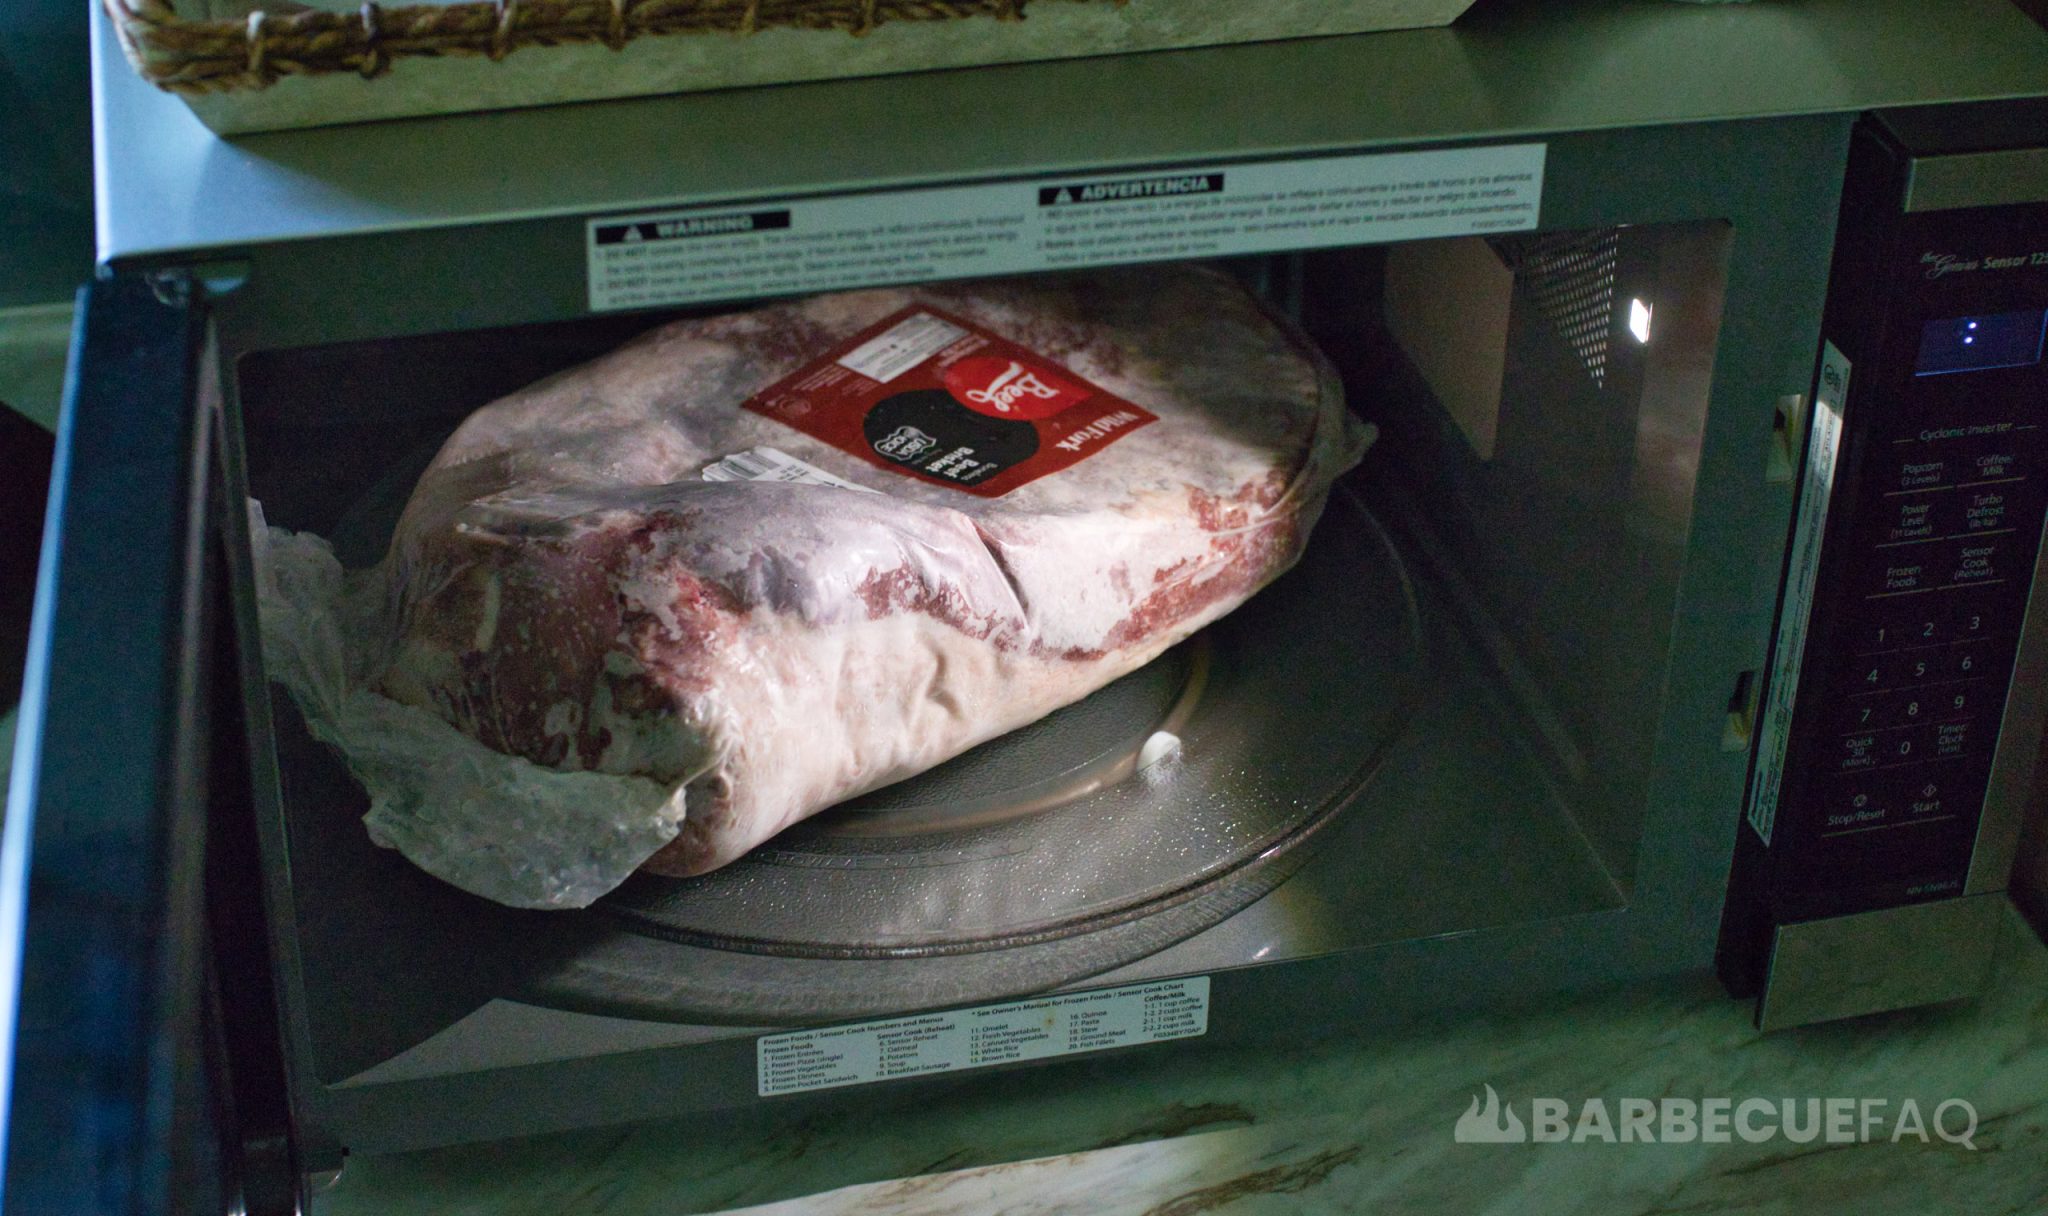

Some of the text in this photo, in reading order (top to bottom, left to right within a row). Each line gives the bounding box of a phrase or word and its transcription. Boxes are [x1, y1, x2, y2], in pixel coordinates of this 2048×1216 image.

[1082, 177, 1209, 200] ADVERTENCIA
[657, 216, 753, 236] WARNING
[1984, 256, 2027, 269] Sensor
[966, 361, 1060, 412] Beef
[1055, 410, 1139, 451] Wild Fork
[1920, 422, 2013, 441] Cyclonic Inverter
[925, 447, 974, 472] Brisket
[943, 459, 980, 478] Beef
[1903, 462, 1943, 474] Popcorn
[1982, 465, 2004, 476] Milk
[1973, 494, 2003, 506] Turbo
[1901, 505, 1930, 514] Power
[1967, 507, 2004, 518] Defrost
[1902, 514, 1925, 526] Level
[1960, 546, 1994, 558] Sensor
[1963, 557, 1988, 569] Cook
[1887, 566, 1921, 576] Frozen
[1886, 576, 1917, 588] Foods
[1923, 622, 1934, 636] 2
[1969, 616, 1980, 630] 3
[1879, 628, 1885, 642] 1
[1961, 656, 1971, 670] 6
[1915, 662, 1926, 677] 5
[1867, 669, 1878, 683] 4
[1953, 695, 1964, 709] 9
[1908, 702, 1919, 715] 8
[1862, 708, 1871, 722] 7
[1846, 736, 1874, 748] Quick
[1938, 733, 1964, 745] Clock
[1900, 741, 1911, 755] 0
[1912, 800, 1940, 813] Start
[1828, 809, 1885, 826] Stop/Reset
[992, 1006, 1021, 1014] Owner's
[1023, 1001, 1050, 1010] Manual
[1090, 993, 1111, 1001] Foods
[1118, 989, 1142, 997] Sensor
[1143, 986, 1162, 994] Cook
[1163, 983, 1184, 991] Chart
[1144, 991, 1185, 1002] Coffee/Milk
[1178, 996, 1200, 1004] coffee
[1081, 1011, 1107, 1019] Quinoa
[1163, 1007, 1180, 1015] cups
[764, 1038, 789, 1046] Frozen
[790, 1034, 813, 1042] Foods
[820, 1030, 844, 1038] Sensor
[847, 1026, 865, 1034] Cook
[867, 1022, 901, 1030] Numbers
[919, 1016, 944, 1024] Menus
[877, 1024, 955, 1040] Sensor Cook (Reheat)
[982, 1024, 1008, 1032] Omelet
[1002, 1027, 1041, 1036] Vegetables
[1162, 1022, 1179, 1030] cups
[982, 1038, 1009, 1047] Canned
[1010, 1033, 1049, 1043] Vegetables
[1080, 1032, 1107, 1040] Ground
[764, 1042, 813, 1054] Frozen Foods
[888, 1044, 918, 1052] Oatmeal
[982, 1046, 1002, 1054] White
[771, 1053, 796, 1061] Frozen
[797, 1058, 815, 1066] Pizza
[797, 1063, 837, 1072] Vegetables
[887, 1066, 920, 1075] Breakfast
[921, 1062, 951, 1070] Sausage
[888, 1061, 906, 1069] Soup
[797, 1072, 825, 1080] Dinners
[797, 1079, 822, 1087] Pocket
[823, 1074, 858, 1083] Sandwich
